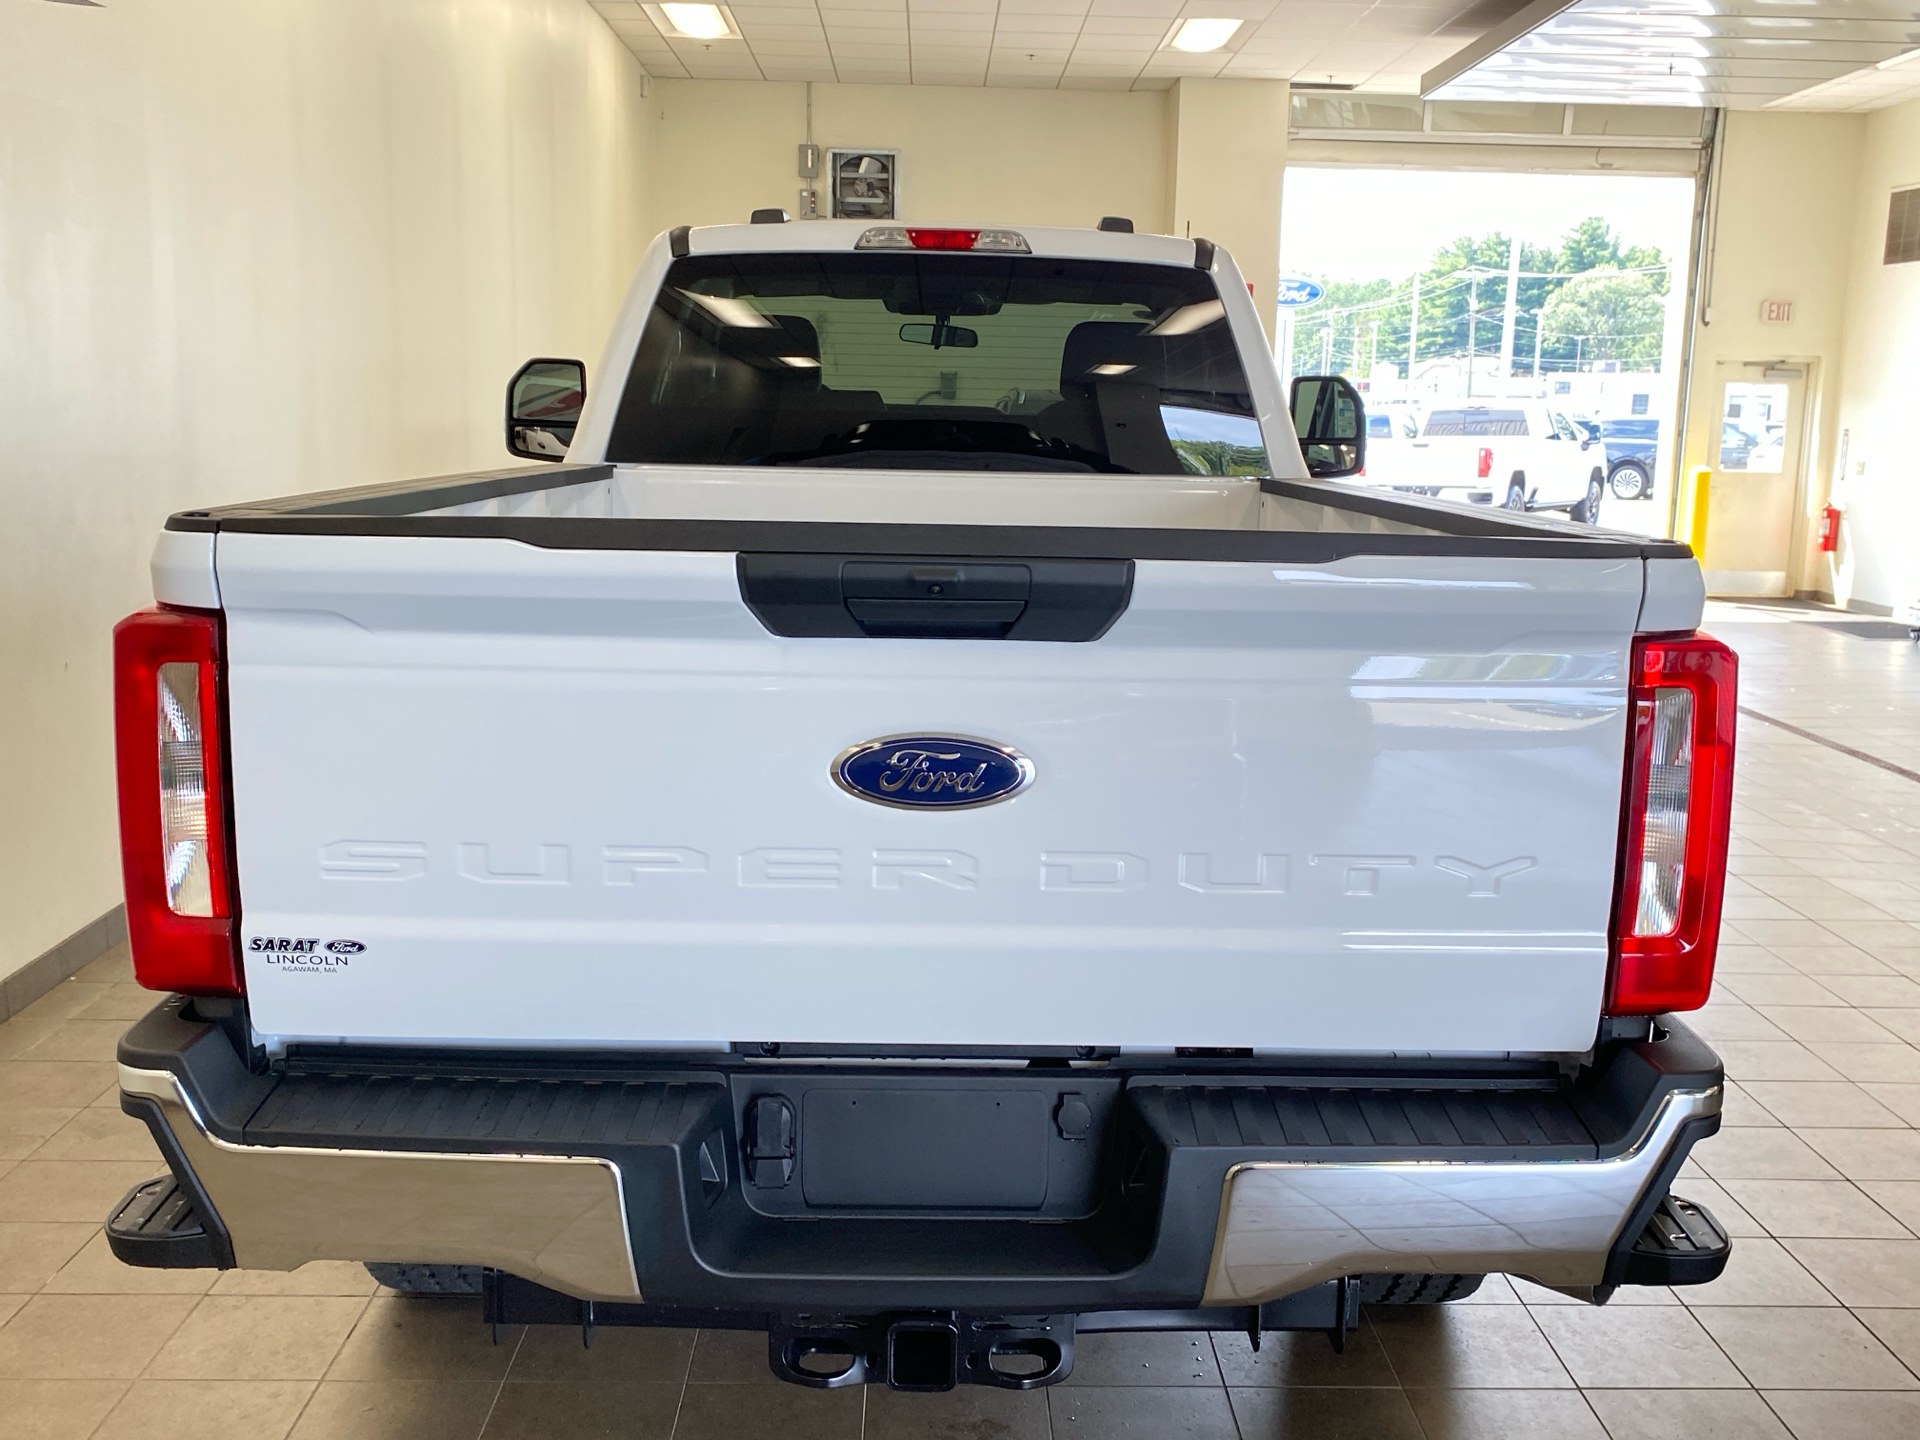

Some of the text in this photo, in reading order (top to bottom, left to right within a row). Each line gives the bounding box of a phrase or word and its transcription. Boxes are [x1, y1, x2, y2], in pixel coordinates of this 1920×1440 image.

[1767, 302, 1793, 321] EXIT
[879, 749, 988, 793] Ford
[318, 839, 1539, 898] SUPER DUTY
[249, 937, 319, 953] SARAT
[266, 954, 349, 966] LINCOLN
[281, 966, 338, 974] AGAWAM, MA
